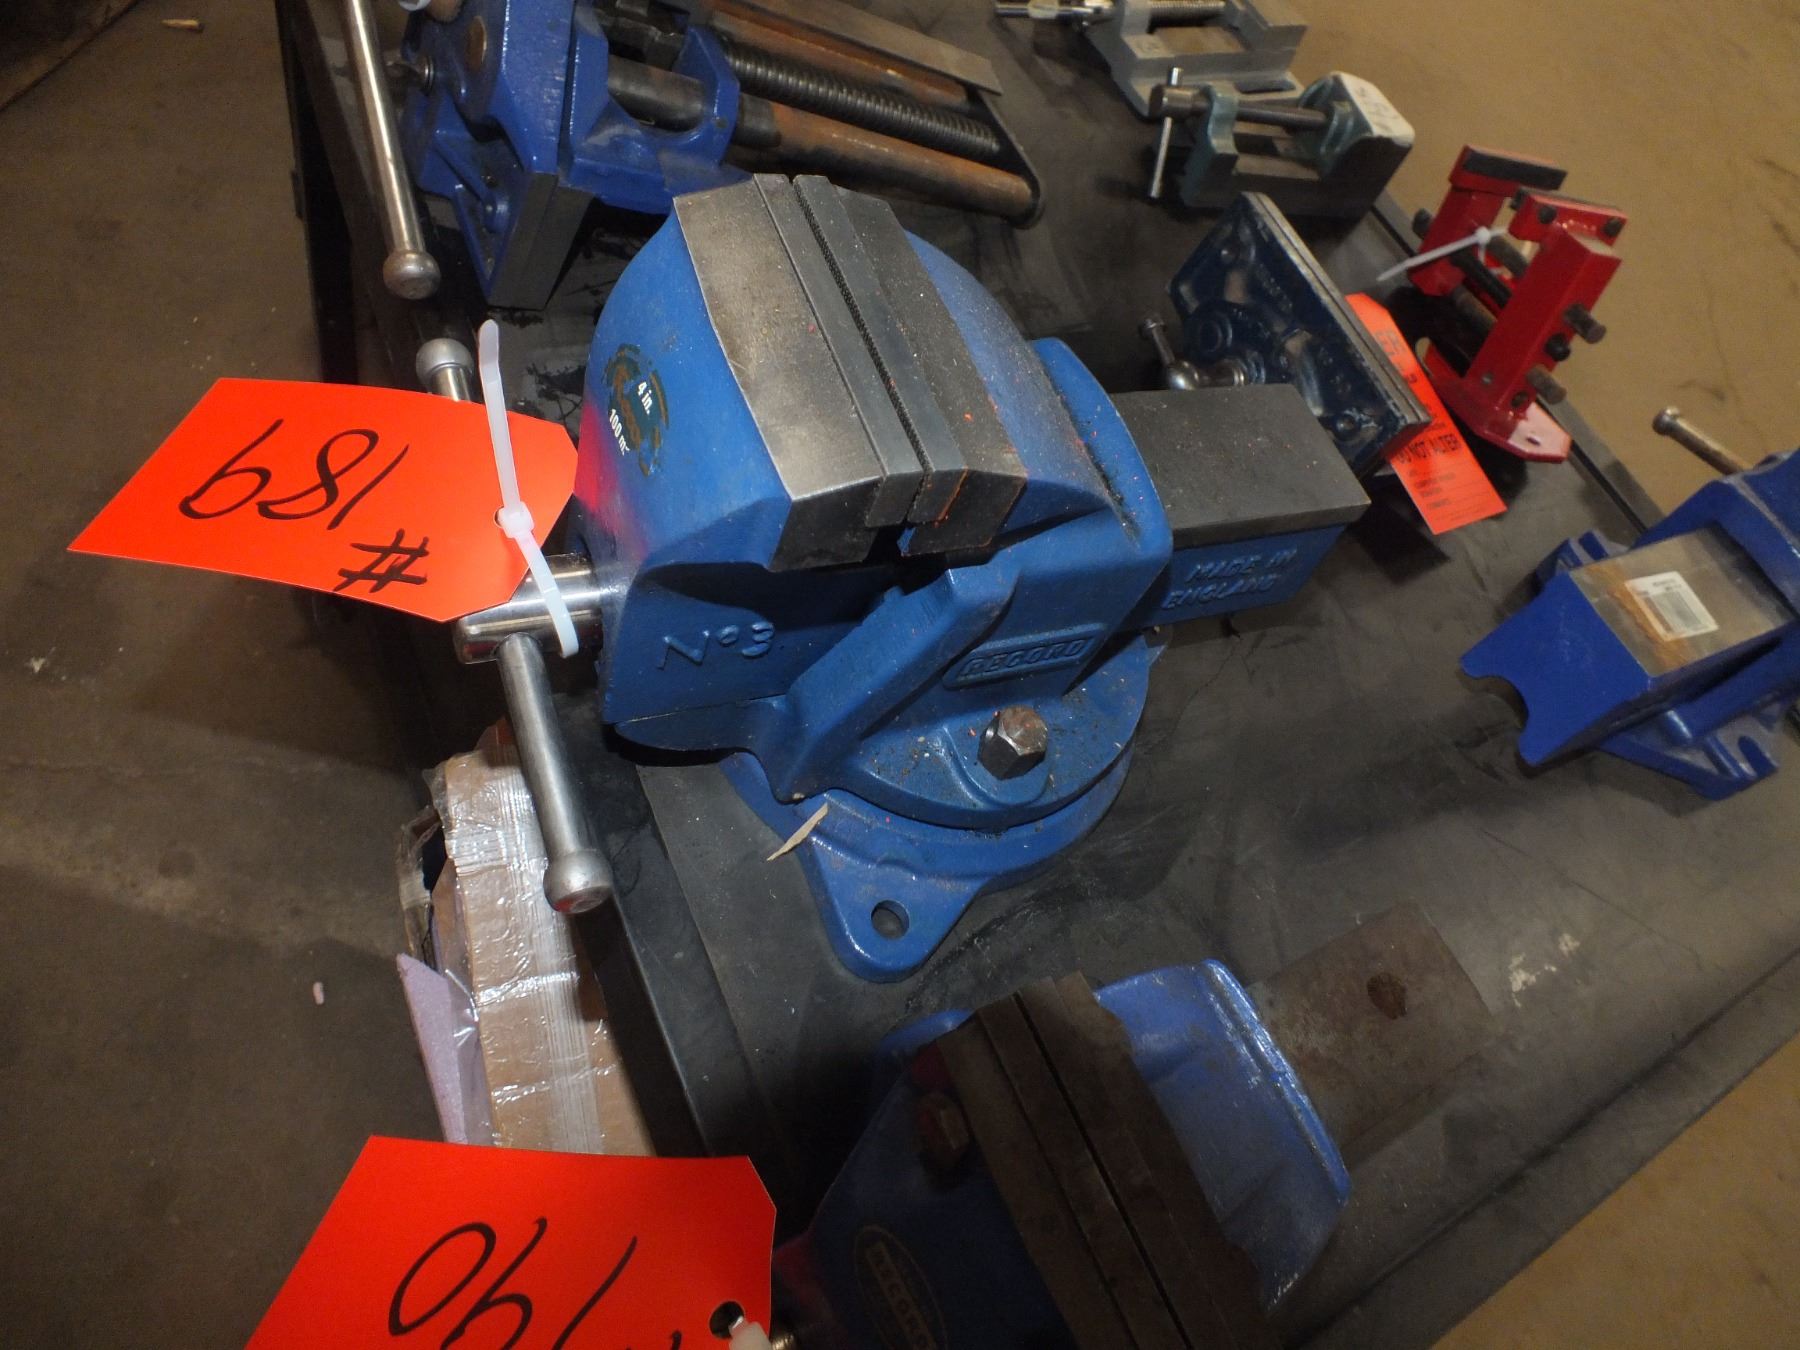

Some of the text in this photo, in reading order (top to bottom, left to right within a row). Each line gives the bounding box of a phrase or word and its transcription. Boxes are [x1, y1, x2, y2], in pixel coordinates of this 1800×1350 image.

[637, 381, 648, 397] 4
[609, 408, 623, 438] 100
[179, 418, 410, 532] 189
[958, 639, 1089, 677] RECORD
